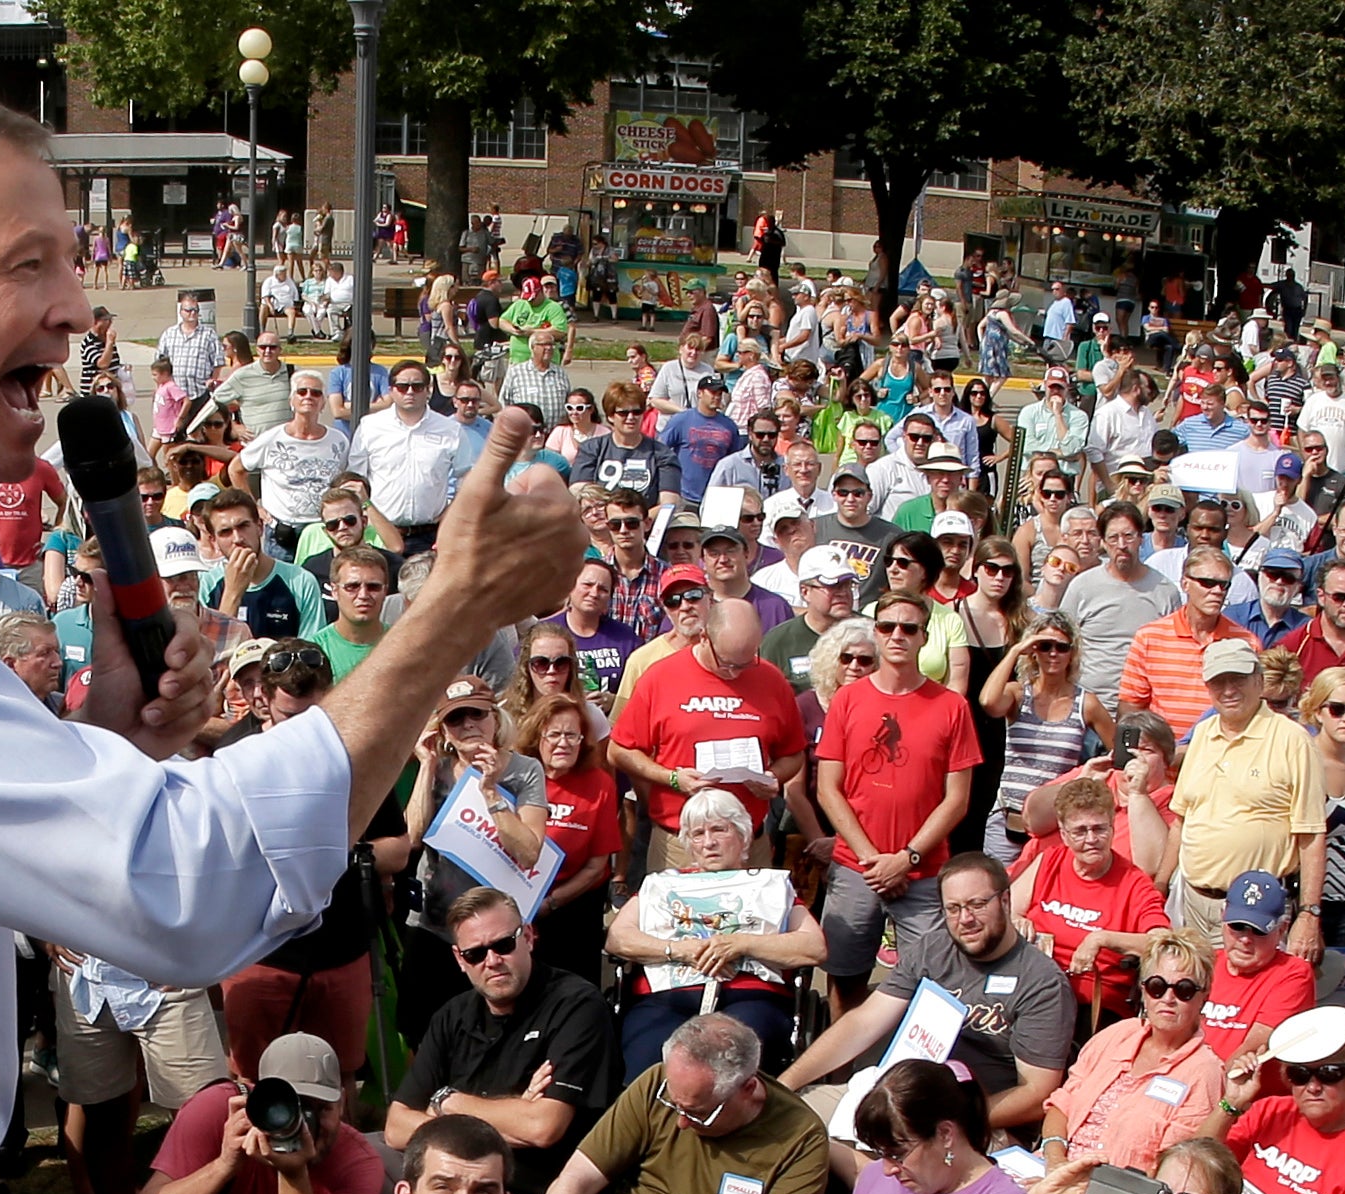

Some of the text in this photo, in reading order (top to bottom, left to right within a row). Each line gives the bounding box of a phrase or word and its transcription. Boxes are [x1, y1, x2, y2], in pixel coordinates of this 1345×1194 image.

[617, 124, 675, 141] CHEESE
[632, 139, 666, 151] STICK
[608, 171, 725, 194] CORN DOGS
[1050, 202, 1152, 228] LEMONADE
[167, 542, 197, 554] Drake
[829, 540, 880, 567] UNI
[596, 656, 621, 669] DAY
[681, 696, 742, 712] AARP
[713, 711, 760, 721] Real Possibilities
[547, 803, 574, 820] RP
[454, 819, 482, 840] REBUILD
[1041, 899, 1102, 923] AARP
[1200, 1000, 1241, 1021] ARP
[908, 1023, 946, 1060] O'MALLEY
[1253, 1142, 1322, 1184] AARP
